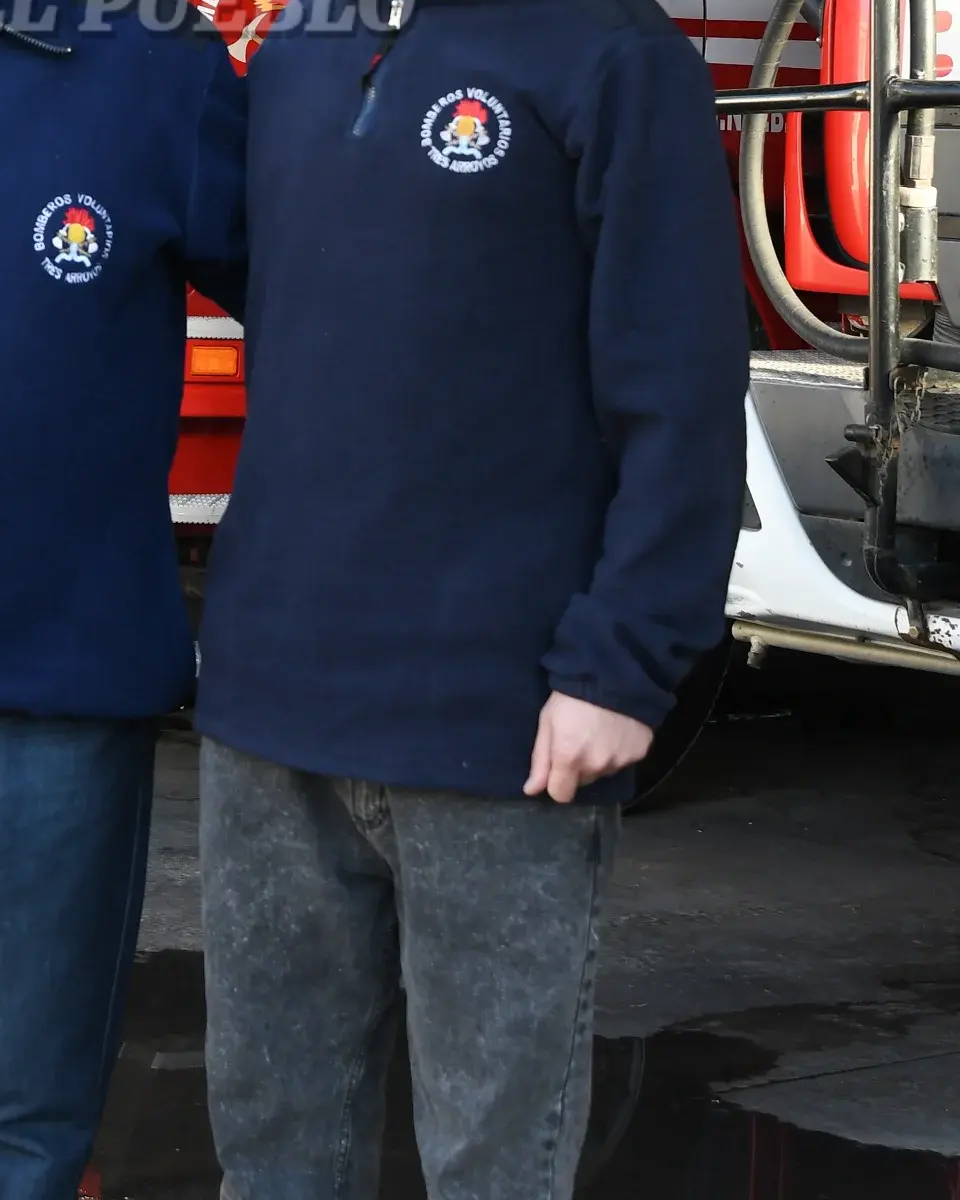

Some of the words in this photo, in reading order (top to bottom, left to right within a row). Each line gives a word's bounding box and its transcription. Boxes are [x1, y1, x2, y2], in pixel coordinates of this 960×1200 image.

[420, 89, 464, 147] BOMBEROS
[466, 87, 512, 157] VOLUNTARIOS
[33, 194, 72, 251] BOMBEROS
